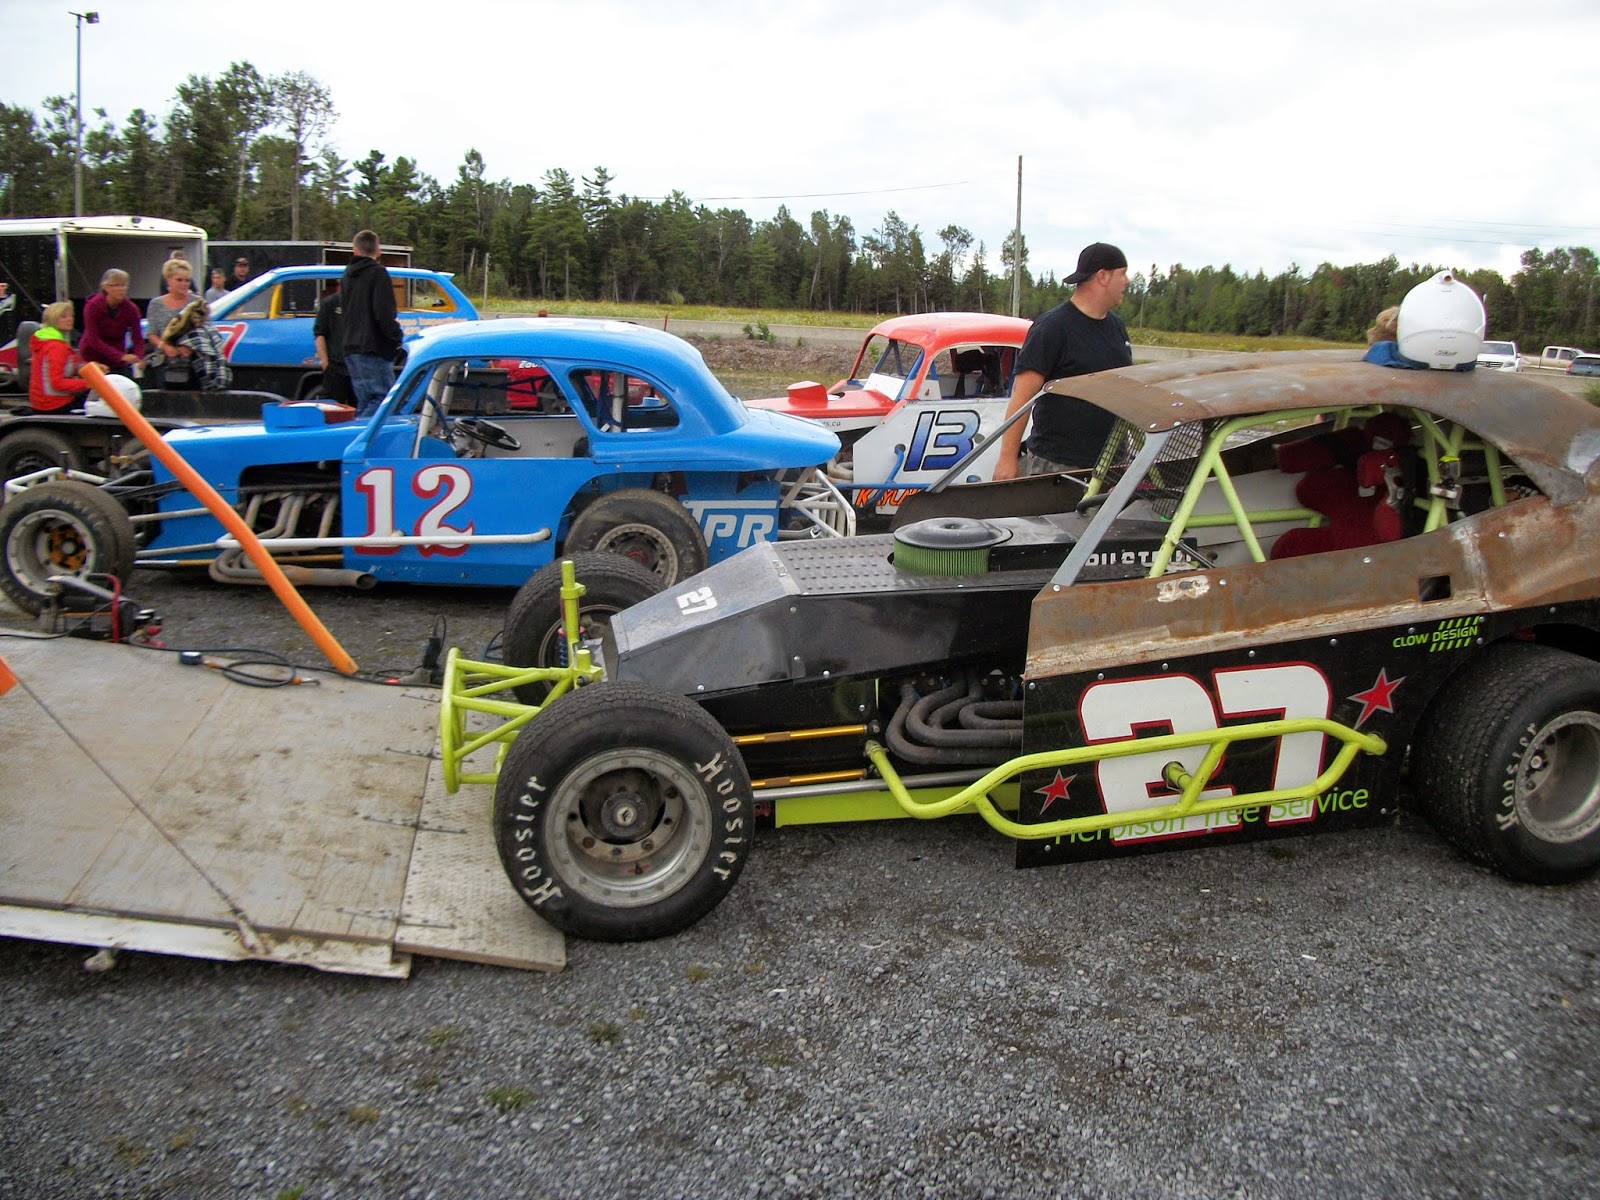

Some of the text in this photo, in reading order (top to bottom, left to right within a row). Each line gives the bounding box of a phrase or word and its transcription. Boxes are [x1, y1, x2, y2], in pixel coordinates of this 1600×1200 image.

[903, 410, 982, 472] 13
[353, 463, 475, 558] 12
[682, 500, 778, 548] TPR
[676, 586, 718, 616] 27
[1392, 626, 1479, 648] CLOW DESIGN
[1077, 660, 1333, 846] 27
[696, 752, 746, 881] Hoosier
[1270, 786, 1369, 820] Service
[514, 775, 564, 905] Hoosier
